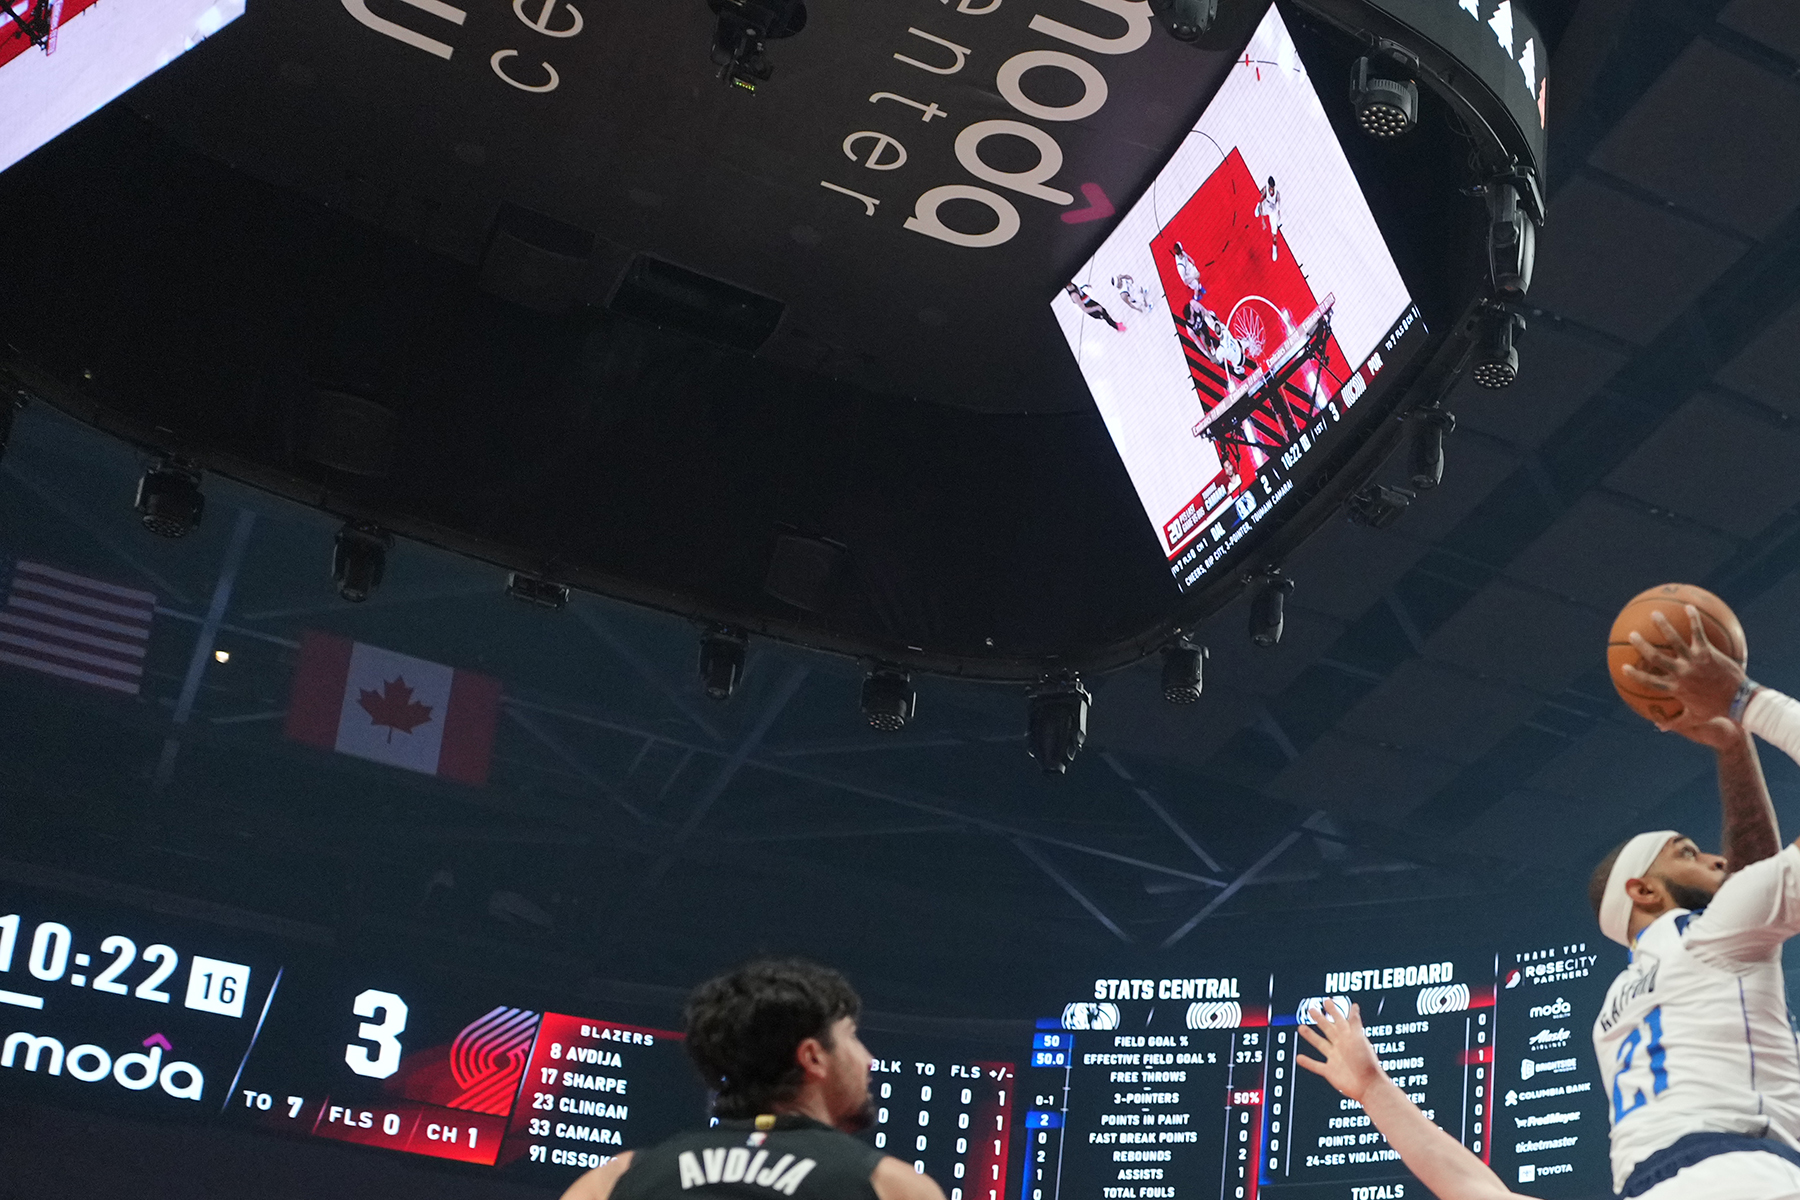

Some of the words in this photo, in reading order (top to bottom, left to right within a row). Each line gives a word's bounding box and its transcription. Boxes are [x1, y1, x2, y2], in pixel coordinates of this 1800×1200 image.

[1366, 351, 1384, 376] POR
[1328, 401, 1340, 422] 3
[1281, 442, 1303, 471] 10:22
[1260, 474, 1272, 495] 2
[1167, 518, 1184, 545] 20
[1210, 521, 1226, 542] DAL
[0, 913, 179, 1004] 10:22
[201, 971, 237, 1004] 16
[1516, 948, 1555, 963] THANK
[1563, 943, 1586, 955] YOU
[1325, 961, 1453, 994] HUSTLEBOARD
[1533, 968, 1589, 985] PARTNERS
[1094, 979, 1155, 1001] STATS
[1158, 978, 1241, 1000] CENTRAL
[1529, 997, 1571, 1018] moda
[345, 988, 409, 1081] 3
[580, 1025, 654, 1046] BLAZERS
[1395, 1021, 1429, 1035] SHOTS
[1043, 1035, 1060, 1047] 50
[1114, 1036, 1145, 1047] FIELD
[1147, 1036, 1177, 1047] GOAL
[1179, 1035, 1189, 1047] %
[1242, 1034, 1259, 1046] 25
[550, 1043, 561, 1059] 8
[566, 1046, 622, 1068] AVDIJA
[1036, 1052, 1065, 1065] 50.0
[1083, 1054, 1141, 1065] EFFECTIVE
[1142, 1054, 1174, 1065] FIELD
[1176, 1053, 1205, 1064] GOAL
[1207, 1053, 1217, 1064] %
[1236, 1051, 1263, 1063] 37.5
[1378, 1057, 1424, 1070] EBOUNDS
[1613, 1005, 1669, 1126] 21
[1, 1032, 204, 1102] moda
[870, 1059, 901, 1073] BLK
[915, 1063, 935, 1075] TO
[950, 1065, 981, 1078] FLS
[1110, 1072, 1139, 1083] FREE
[1141, 1071, 1187, 1083] THROWS
[541, 1067, 558, 1084] 17
[562, 1072, 627, 1095] SHARPE
[1409, 1075, 1428, 1086] PTS
[1035, 1095, 1054, 1106] 0-1
[1114, 1093, 1180, 1104] 3-POINTERS
[1234, 1092, 1260, 1104] 50%
[1518, 1086, 1565, 1101] COLUMBIA
[1565, 1082, 1591, 1094] BANK
[532, 1092, 554, 1110] 23
[559, 1097, 629, 1121] CLINGAN
[243, 1089, 272, 1112] TO
[287, 1096, 304, 1119] 7
[328, 1105, 373, 1130] FLS
[382, 1113, 400, 1136] 0
[426, 1123, 457, 1145] CH
[467, 1127, 478, 1149] 1
[1040, 1114, 1050, 1127] 2
[1101, 1114, 1140, 1126] POINTS
[1142, 1114, 1156, 1126] IN
[1157, 1113, 1190, 1125] PAINT
[1329, 1116, 1370, 1129] FORCED
[529, 1118, 550, 1137] 33
[555, 1123, 622, 1146] CAMARA
[1089, 1133, 1118, 1144] FAST
[1119, 1132, 1157, 1144] BREAK
[1158, 1131, 1198, 1143] POINTS
[1318, 1135, 1356, 1148] POINTS
[1359, 1133, 1380, 1145] OFF
[1515, 1136, 1579, 1154] ticketmaster
[529, 1145, 547, 1163] 91
[551, 1149, 618, 1168] CISSOK
[1036, 1150, 1046, 1163] 2
[1112, 1150, 1172, 1162] REBOUNDS
[1238, 1148, 1247, 1160] 2
[1306, 1154, 1345, 1167] 24-SEC
[1349, 1150, 1401, 1163] VIOLATION
[678, 1147, 817, 1196] AVDIJA
[1036, 1168, 1043, 1181] 1
[1117, 1168, 1164, 1180] ASSISTS
[1238, 1166, 1244, 1178] 1
[1537, 1163, 1573, 1177] TOYOTA
[1103, 1187, 1137, 1199] TOTAL
[1139, 1187, 1175, 1198] FOULS
